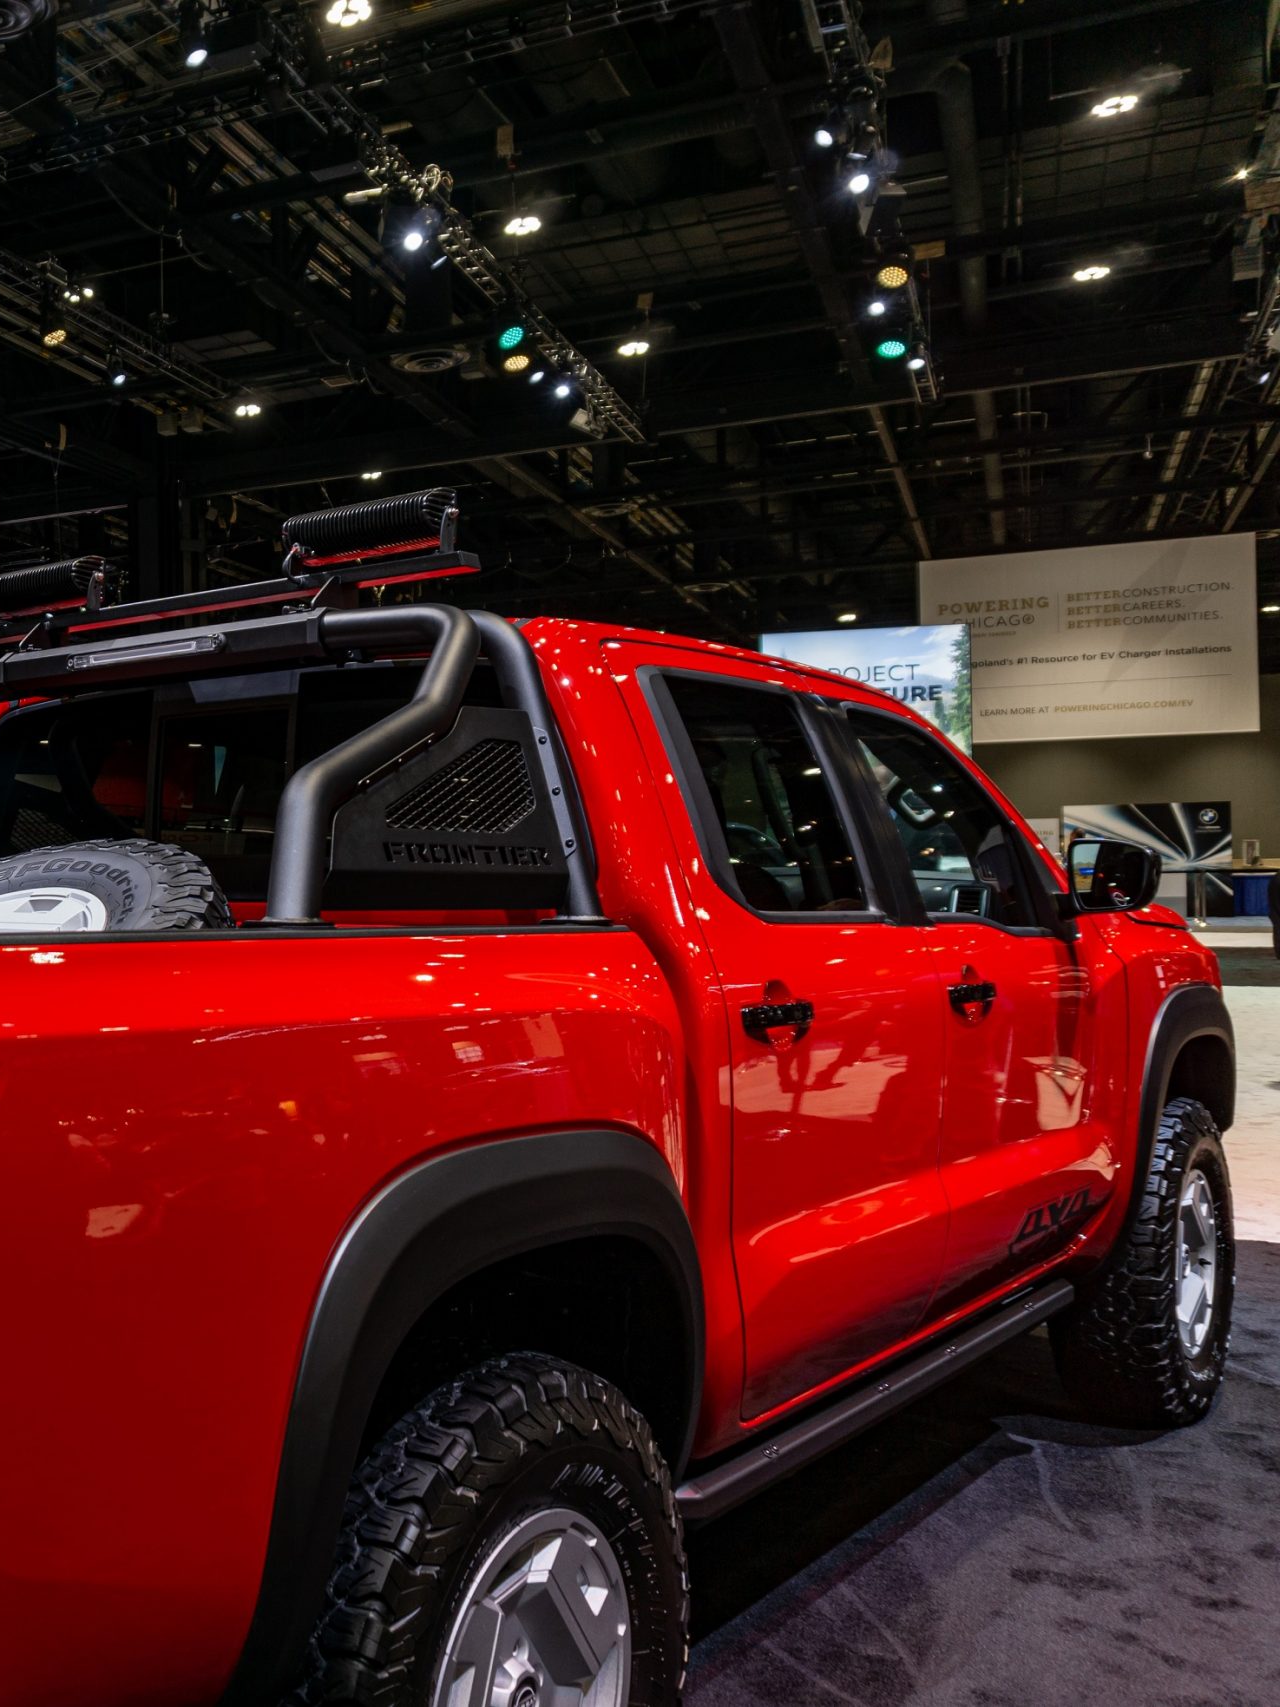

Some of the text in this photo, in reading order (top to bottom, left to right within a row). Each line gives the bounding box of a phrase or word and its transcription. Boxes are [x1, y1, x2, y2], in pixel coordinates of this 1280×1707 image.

[937, 596, 1050, 616] POWERING
[1017, 656, 1029, 665] #1
[1031, 653, 1079, 665] Resource
[1082, 652, 1098, 662] for
[1100, 651, 1115, 660] EV
[1118, 649, 1162, 660] Charger
[1165, 644, 1233, 657] Installations
[980, 699, 1194, 717] LEARN MORE AT POWERINGCHICAGO.COM/EV
[382, 840, 553, 867] FRONTIER
